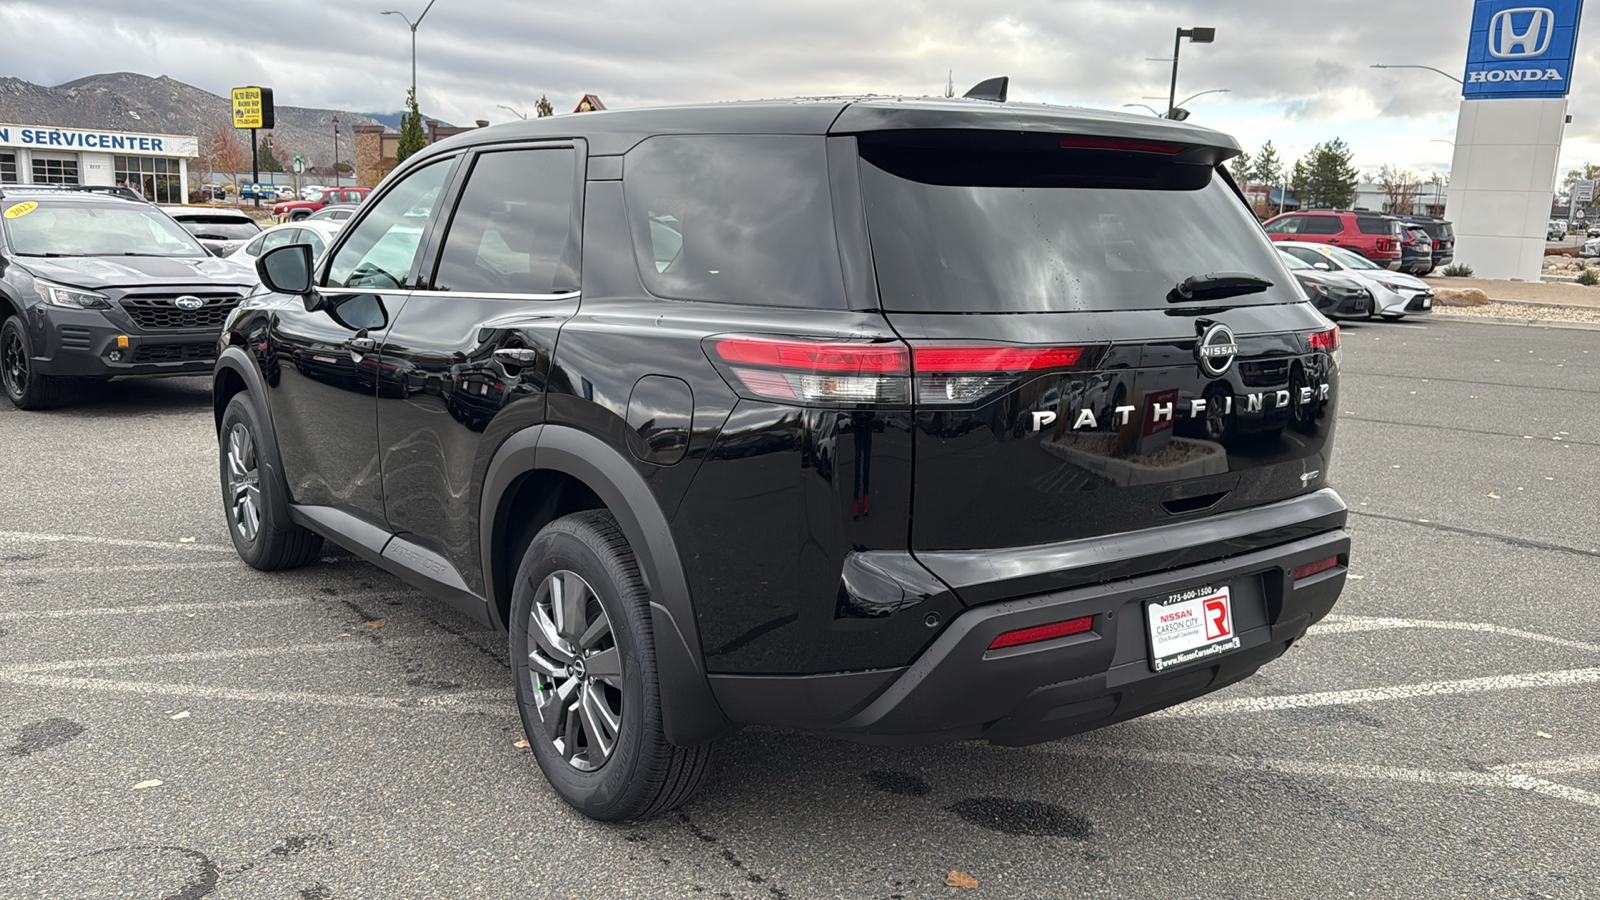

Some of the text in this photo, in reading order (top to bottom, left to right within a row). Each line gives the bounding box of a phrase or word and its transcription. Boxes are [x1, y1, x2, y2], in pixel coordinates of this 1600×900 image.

[1468, 69, 1563, 83] HONDA
[21, 129, 164, 151] SERVICENTER
[10, 202, 33, 216] 2022
[1201, 345, 1238, 356] NISSAN
[1031, 383, 1330, 432] PATHFINDER
[1168, 586, 1212, 603] 775-600-1500
[1160, 609, 1193, 623] NISSAN
[1156, 617, 1198, 635] CARSON CITY
[1162, 640, 1234, 667] www.NissanCarsonCity.com
